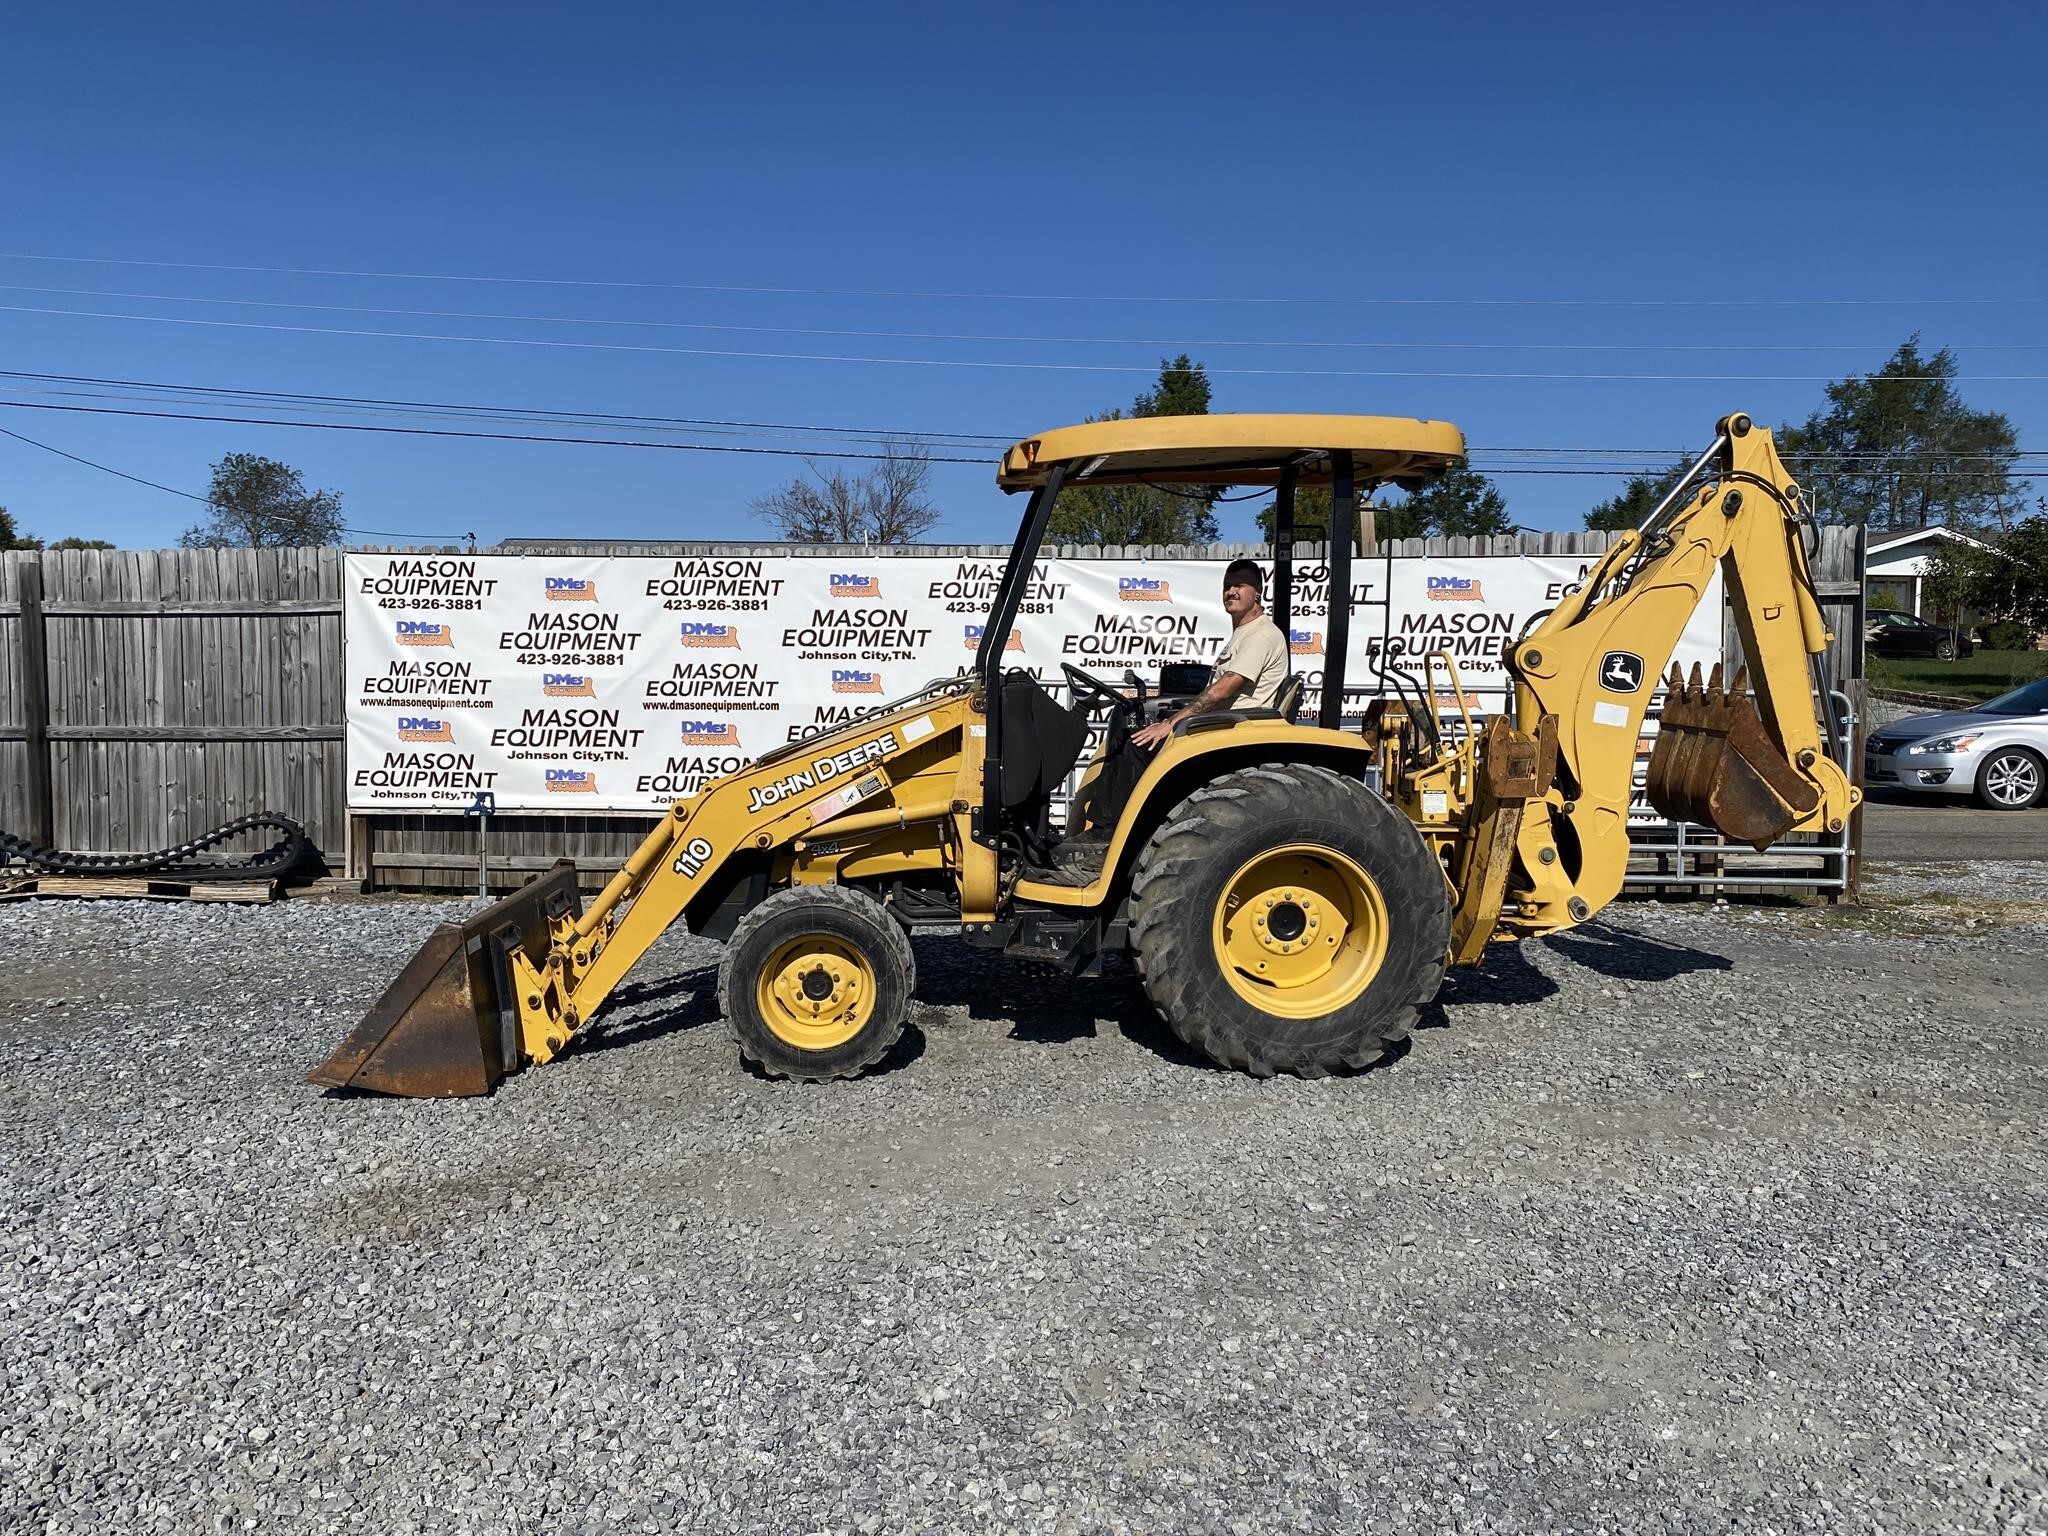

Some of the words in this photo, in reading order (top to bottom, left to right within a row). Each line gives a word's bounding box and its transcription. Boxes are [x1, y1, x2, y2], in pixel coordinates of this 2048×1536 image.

[388, 561, 475, 577] MASON
[674, 561, 762, 577] MASON
[957, 564, 1048, 581] MASN
[361, 578, 498, 596] EQUIPMENT
[646, 580, 784, 596] EQUIPMENT
[928, 582, 1071, 600] EQUIPENT
[379, 598, 481, 610] 423-926-3881
[663, 600, 767, 610] 423-926-3881
[528, 613, 618, 631] MASON
[812, 609, 907, 627] MASON
[1094, 614, 1198, 634] MASON
[1400, 613, 1514, 633] MASON
[500, 632, 641, 650] EQUIPMENT
[782, 629, 932, 647] EQUIPMENT
[1062, 635, 1224, 656] EQUIPMENT
[517, 654, 623, 665] 423-926-3881
[798, 651, 856, 659] Johnson
[1080, 658, 1142, 668] Johnson
[388, 661, 471, 679] MASON
[673, 664, 758, 679] MASON
[1458, 660, 1503, 673] City,T
[364, 678, 491, 694] EQUIPMENT
[646, 681, 779, 696] EQUIPMENT
[360, 697, 493, 710] www.dmasonequipment.com
[643, 700, 779, 712] www.dmasonequipment.com
[522, 709, 619, 727] MASON
[491, 729, 644, 747] EQUIPMENT
[384, 753, 474, 770] MASON
[508, 751, 567, 759] Johnson
[812, 731, 900, 783] DEERE
[355, 769, 498, 788] EQUIPMENT
[370, 790, 427, 799] Johnson
[431, 790, 477, 800] City,TN
[673, 838, 713, 879] 110
